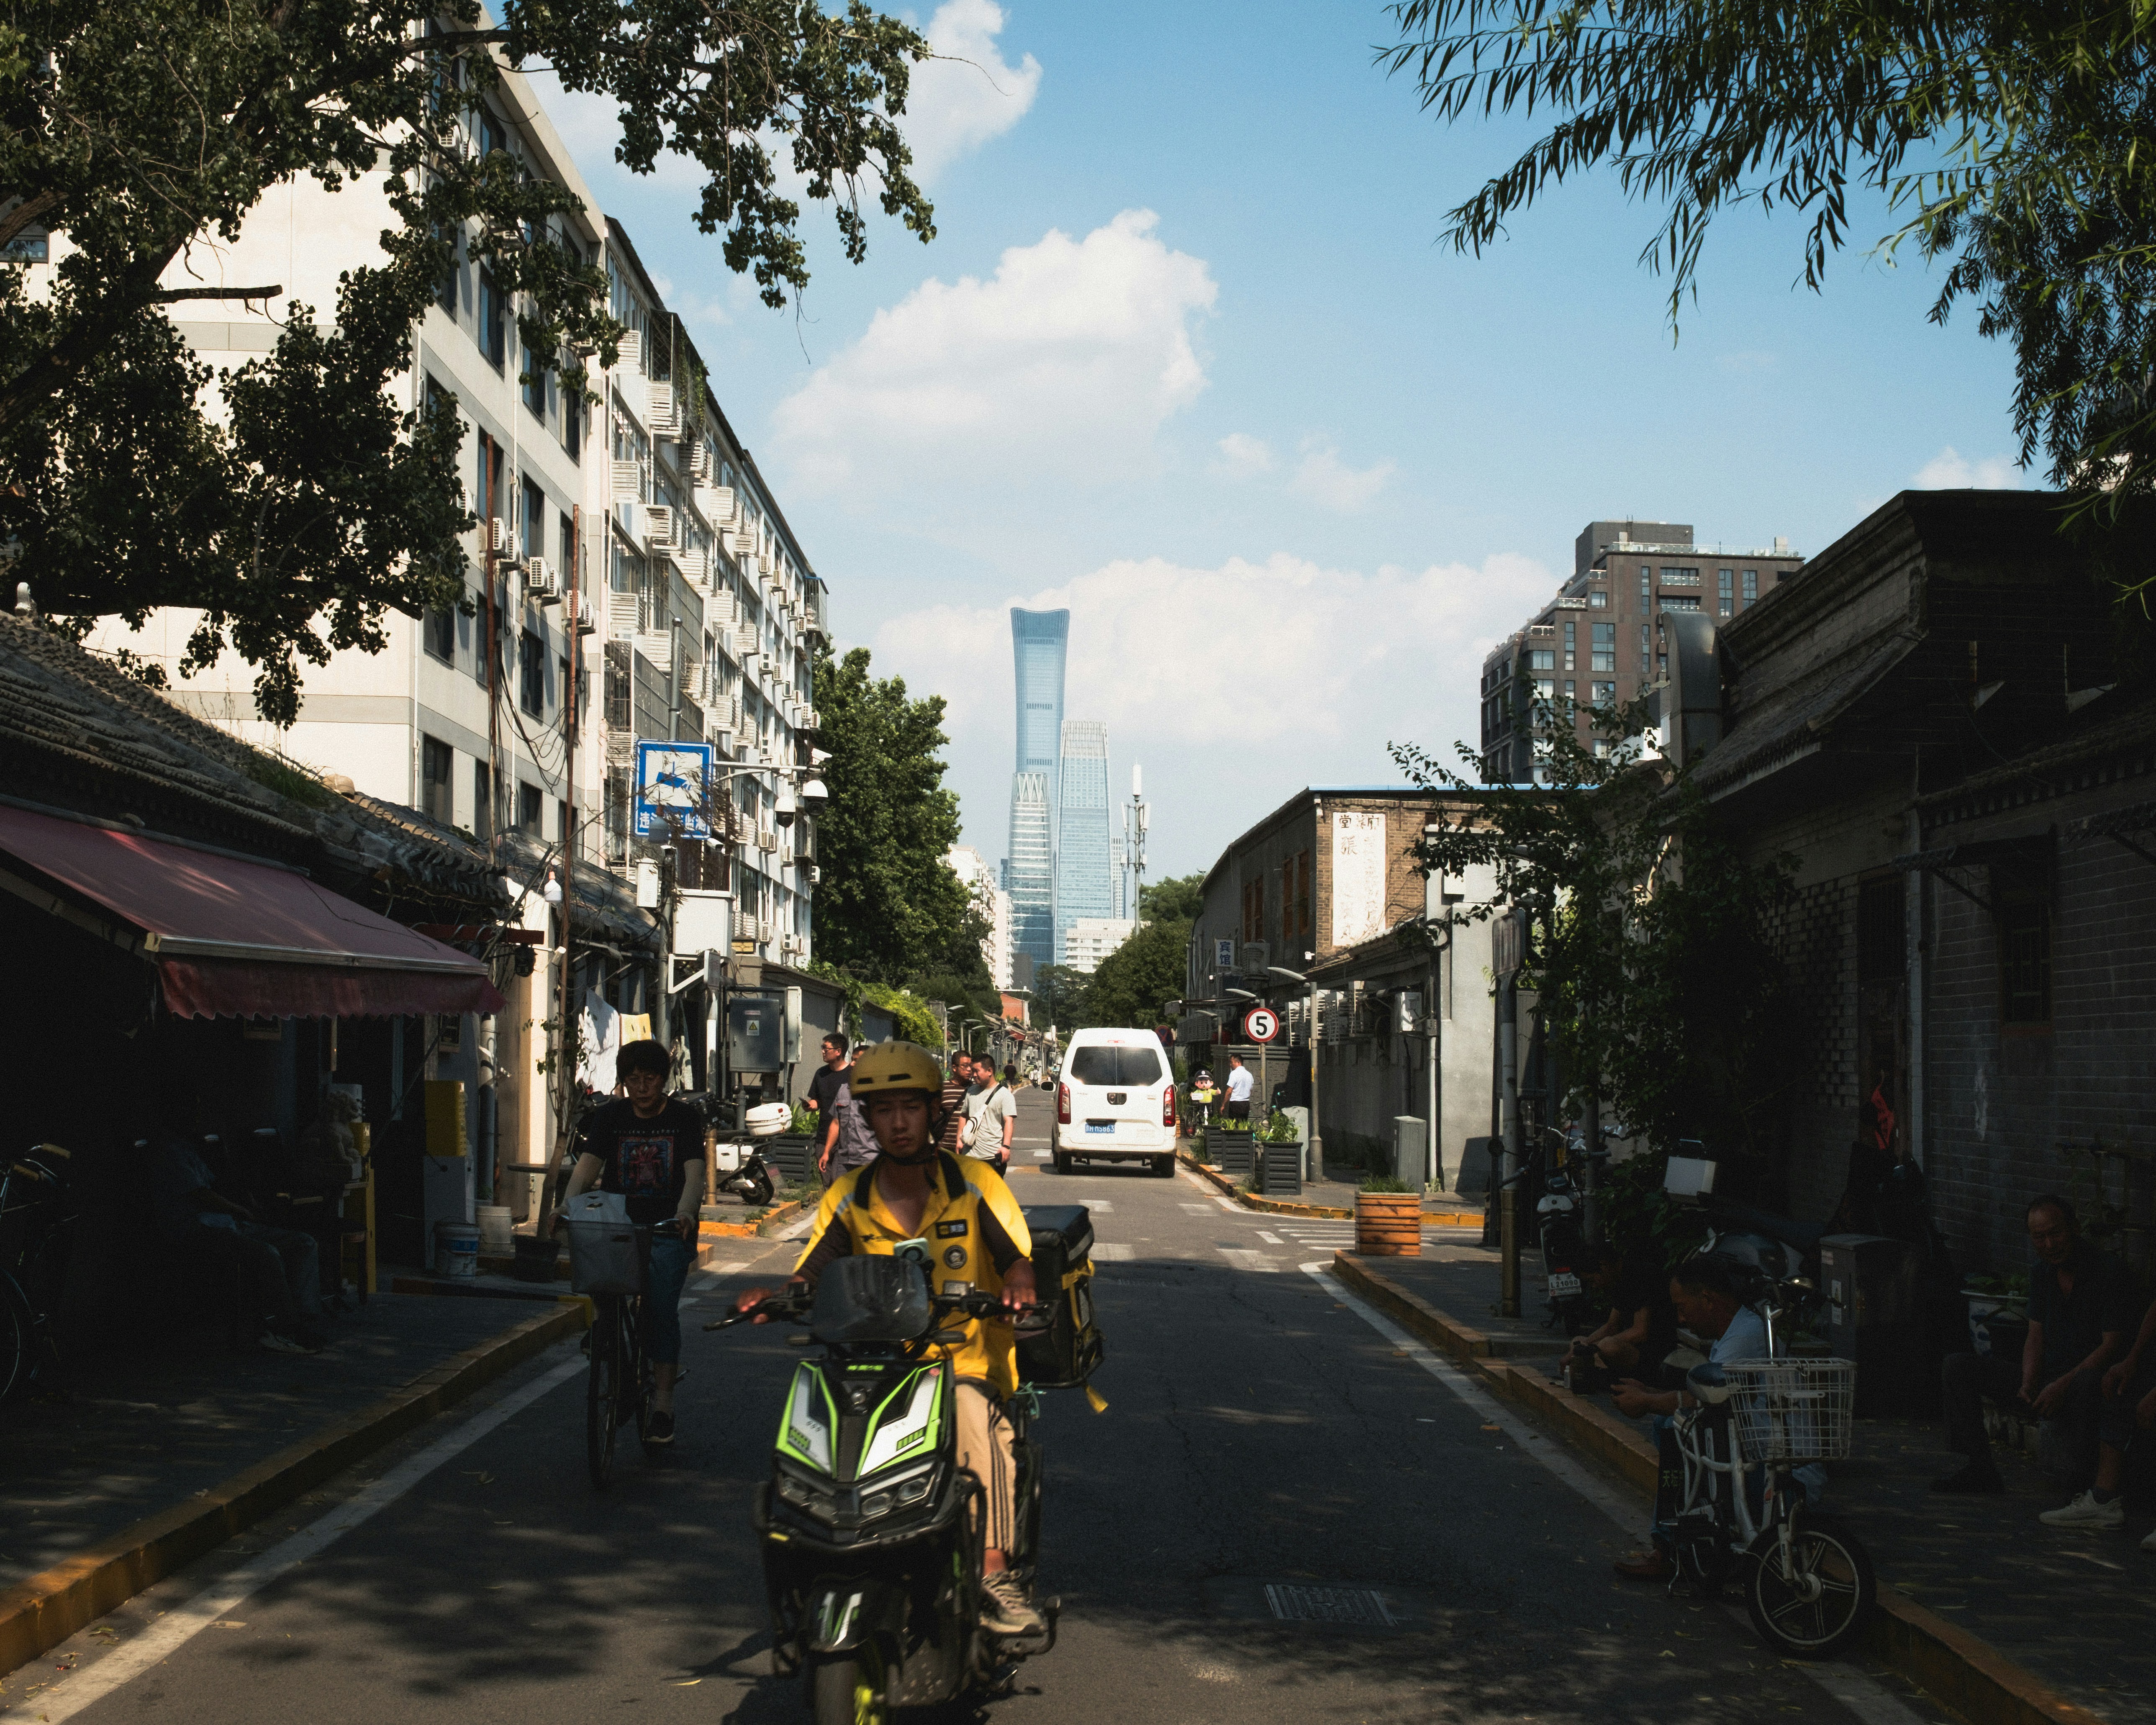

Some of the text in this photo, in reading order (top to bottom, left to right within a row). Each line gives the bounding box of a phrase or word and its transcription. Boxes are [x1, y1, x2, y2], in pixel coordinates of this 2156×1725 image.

[1219, 941, 1231, 965] 宾馆
[1256, 1016, 1267, 1036] 5
[1550, 1279, 1578, 1289] L21090
